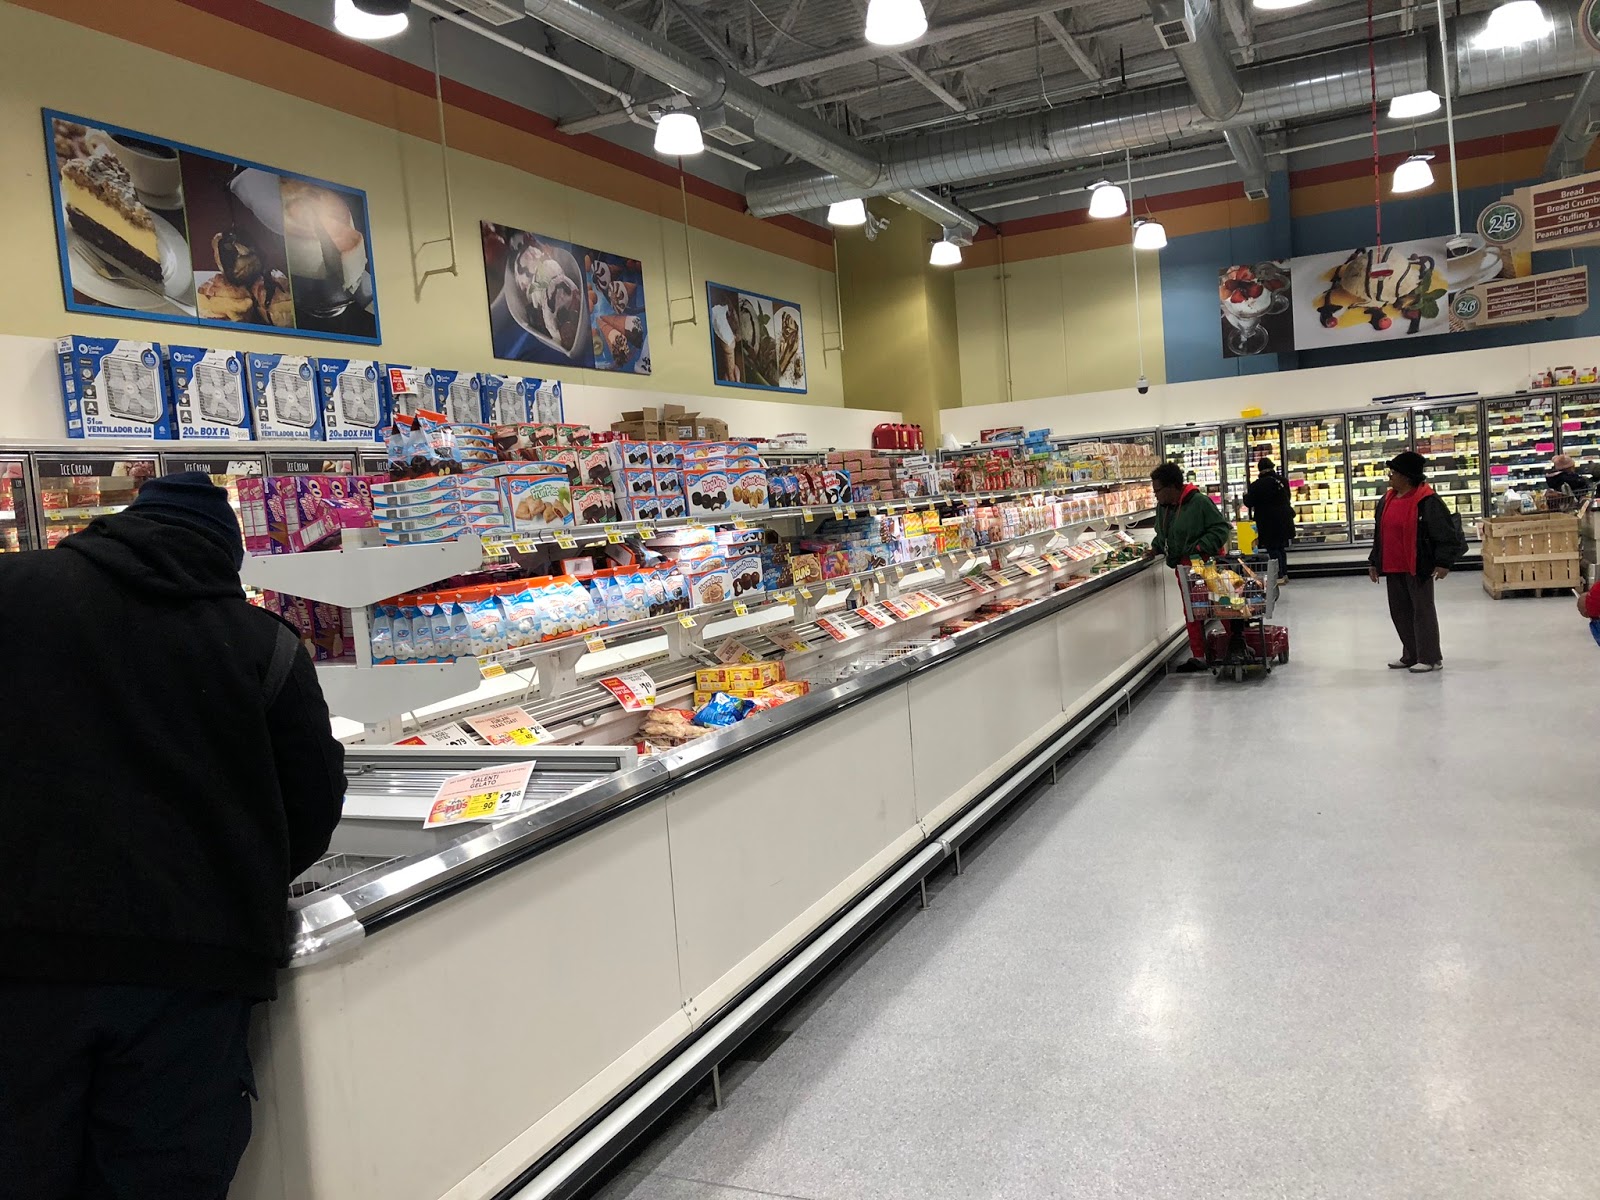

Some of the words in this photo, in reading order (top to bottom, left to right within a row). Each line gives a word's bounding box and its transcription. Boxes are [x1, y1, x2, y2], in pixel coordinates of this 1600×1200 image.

[1561, 187, 1584, 198] Bread
[1546, 202, 1569, 214] Bread
[1572, 196, 1600, 208] Crumb
[1558, 211, 1590, 223] Stuffing
[1488, 212, 1516, 234] 25
[1536, 230, 1562, 239] Peanut
[1563, 224, 1586, 234] Butter
[1457, 300, 1476, 313] 26
[200, 427, 218, 435] BOX
[60, 463, 70, 475] ICE
[71, 463, 93, 475] CREAM
[184, 463, 192, 473] ICE
[193, 463, 211, 474] CREAM
[286, 462, 294, 472] ICE
[294, 462, 309, 472] CREAM
[795, 565, 810, 582] BUNS
[470, 780, 496, 789] GELATO
[472, 775, 500, 783] TALENTI
[445, 802, 467, 813] PLUS
